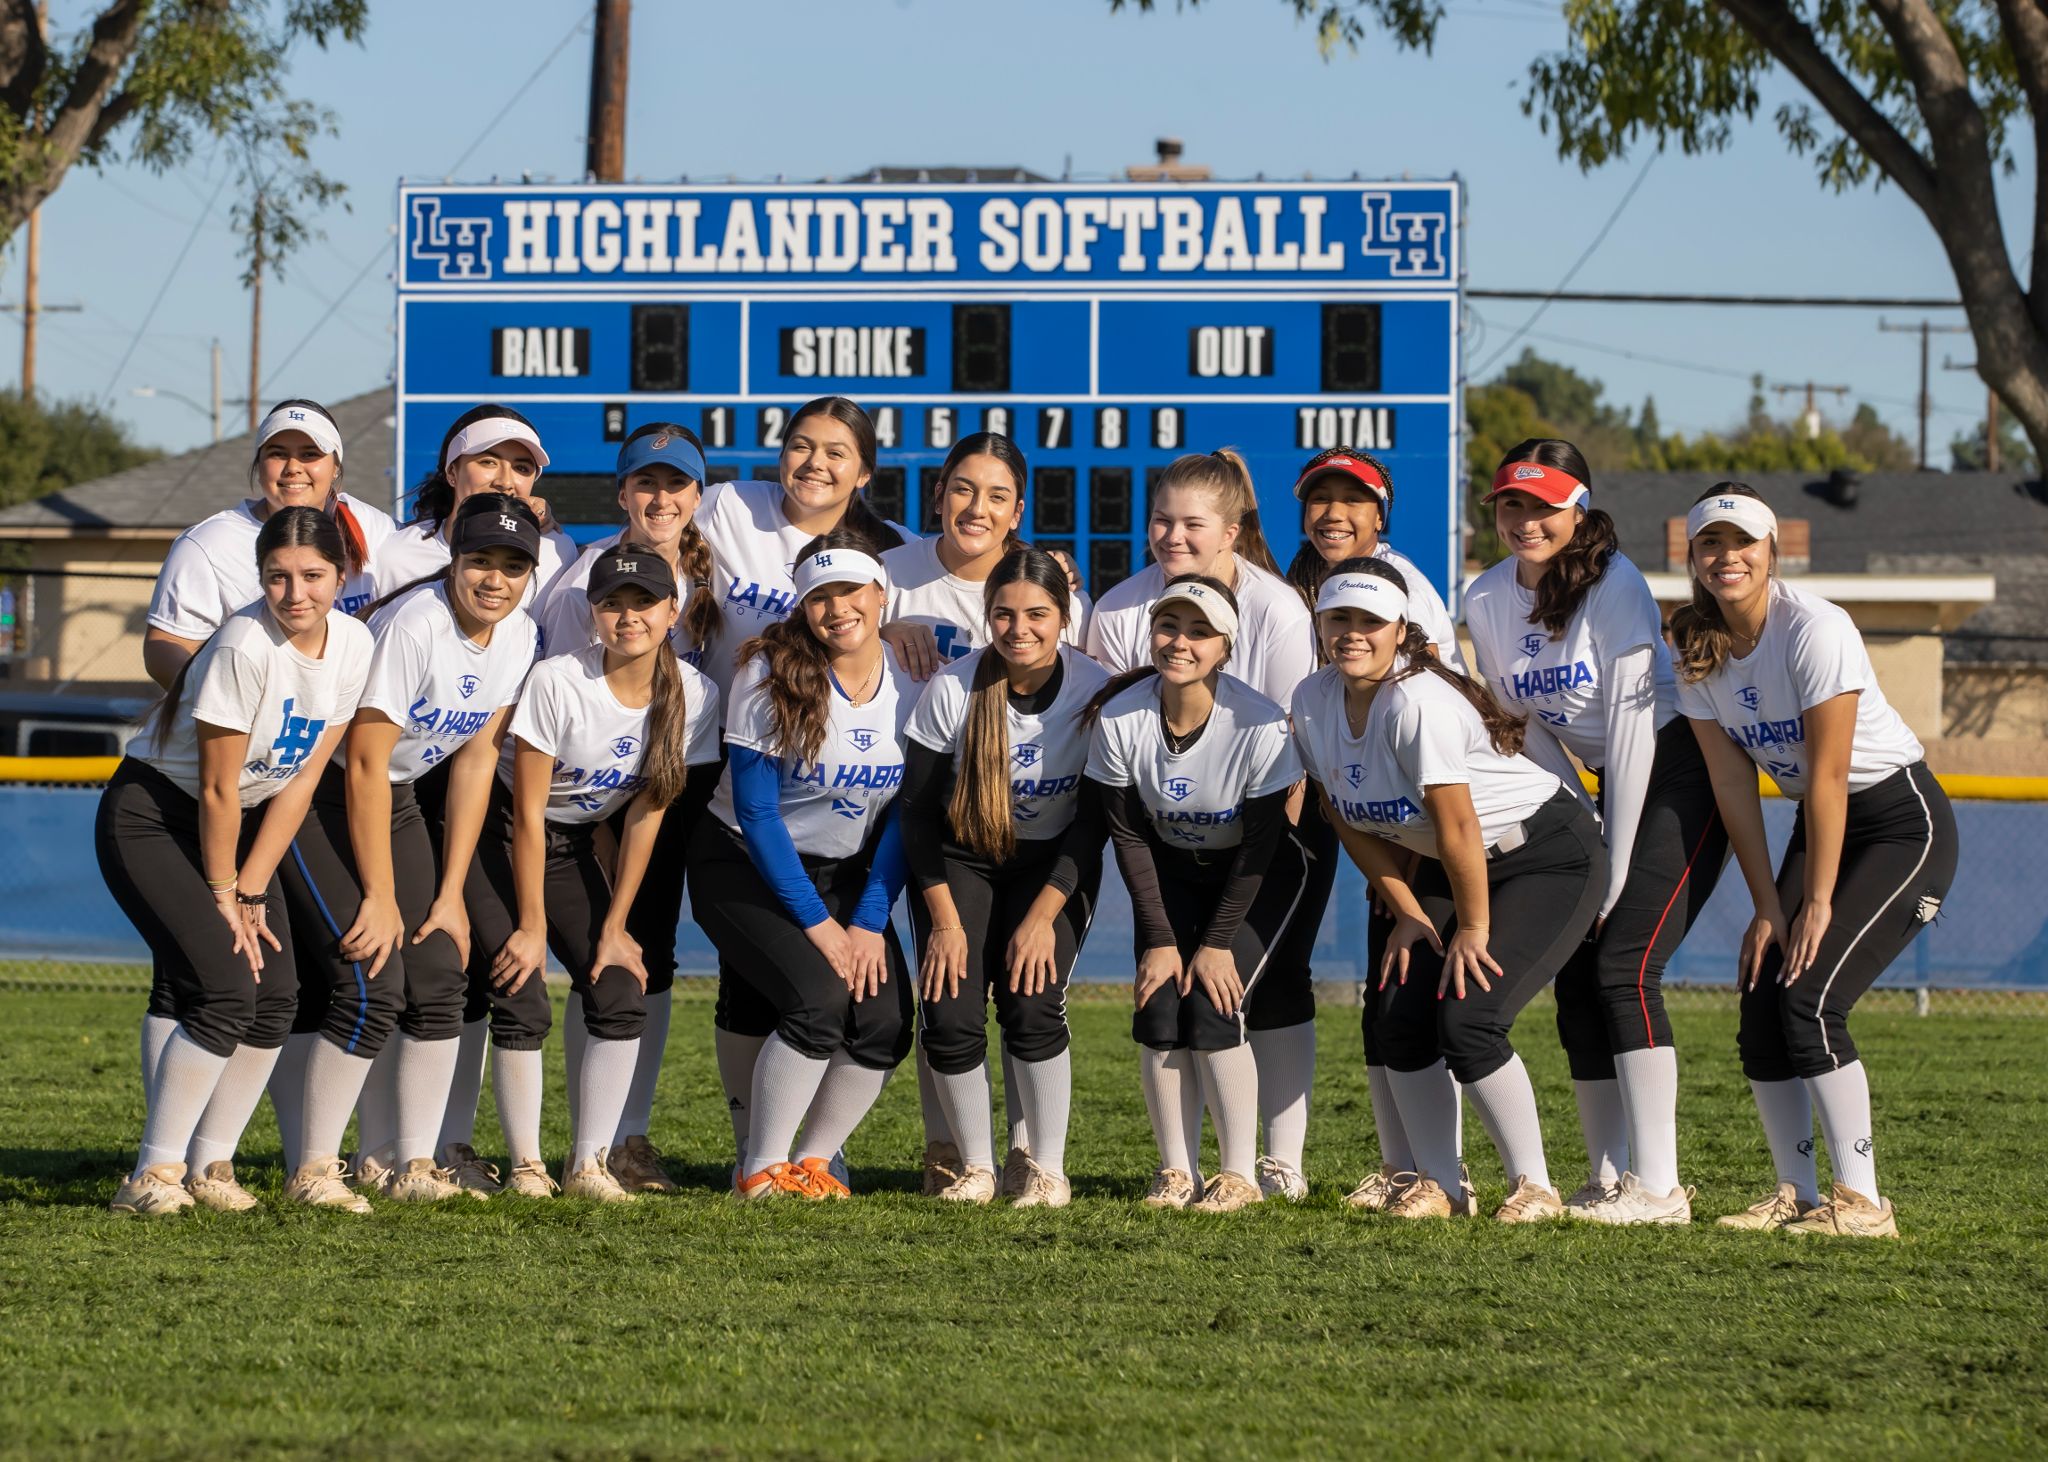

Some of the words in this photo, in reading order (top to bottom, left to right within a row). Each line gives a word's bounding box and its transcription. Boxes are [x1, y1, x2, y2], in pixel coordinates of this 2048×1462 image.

[412, 196, 493, 280] LH
[502, 199, 957, 275] HIGHLANDER
[979, 197, 1345, 273] SOFTBALL
[1361, 191, 1446, 277] LH
[501, 327, 579, 378] BALL
[792, 327, 913, 377] STRIKE
[1197, 326, 1266, 377] OUT
[710, 406, 726, 448] 1
[763, 406, 784, 448] 2
[875, 406, 895, 448] 4
[930, 406, 951, 449] 5
[1045, 407, 1065, 449] 7
[1100, 407, 1122, 449] 8
[1157, 407, 1178, 449] 9
[1299, 408, 1392, 449] TOTAL
[499, 514, 517, 532] LH
[616, 558, 638, 573] LH
[814, 553, 833, 568] LH
[726, 576, 760, 607] LA
[1337, 579, 1379, 592] Cruisers
[1512, 660, 1594, 699] HABRA
[408, 696, 442, 730] LA
[855, 730, 871, 747] LH
[832, 763, 905, 789] HABR
[1168, 780, 1188, 796] LH
[1342, 795, 1420, 823] HABRA
